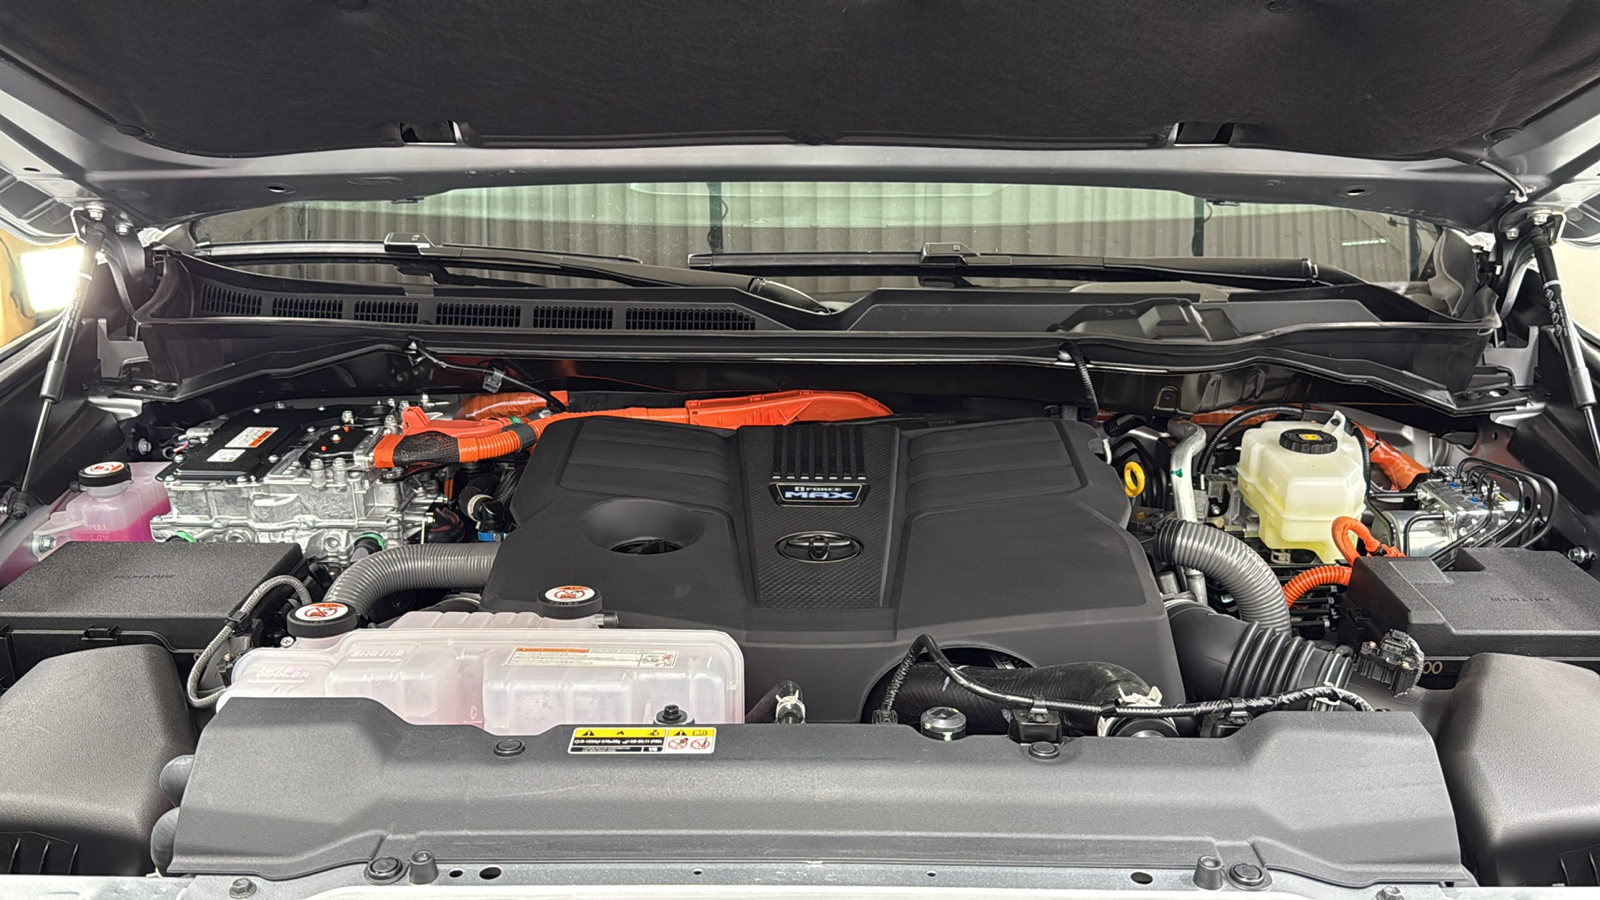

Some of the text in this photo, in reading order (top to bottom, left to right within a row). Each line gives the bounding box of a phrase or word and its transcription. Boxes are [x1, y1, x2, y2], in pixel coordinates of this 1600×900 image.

[784, 491, 854, 499] MAX
[88, 523, 107, 531] FULL
[90, 533, 111, 541] LOW
